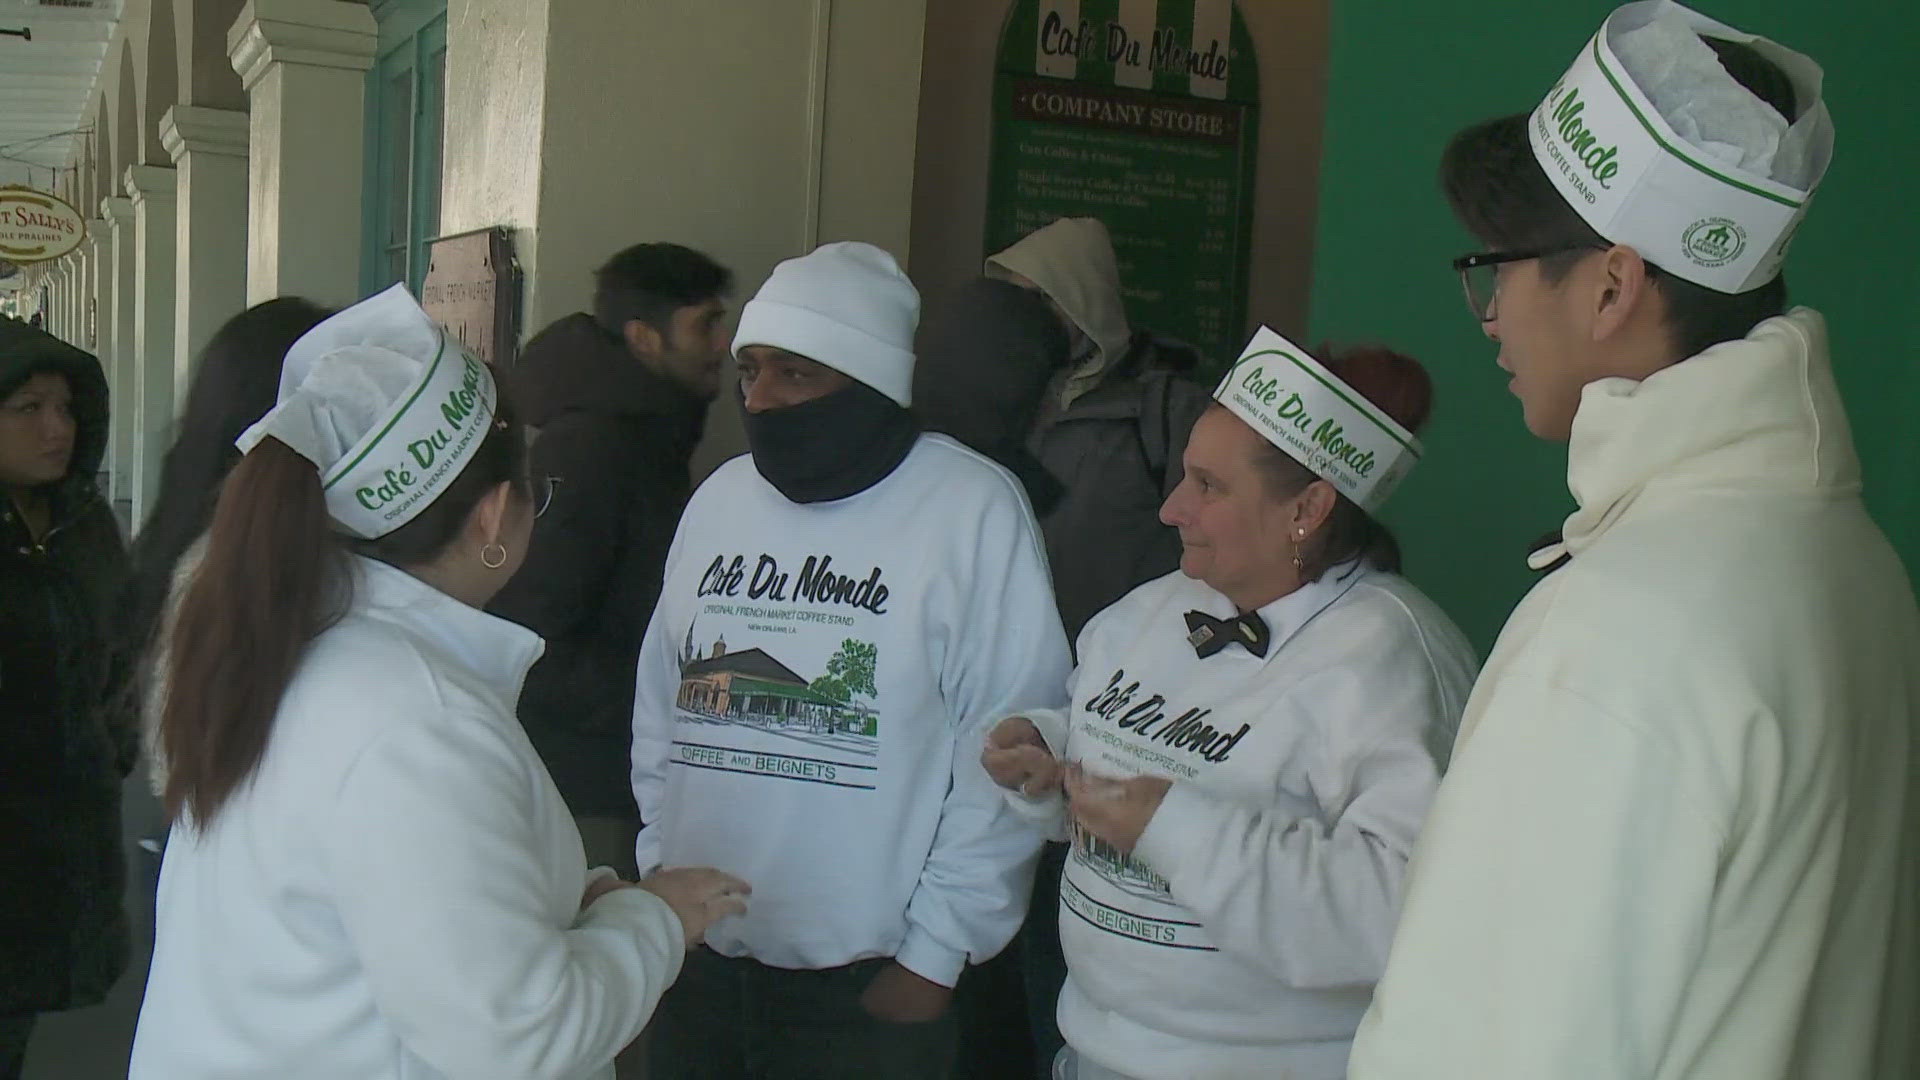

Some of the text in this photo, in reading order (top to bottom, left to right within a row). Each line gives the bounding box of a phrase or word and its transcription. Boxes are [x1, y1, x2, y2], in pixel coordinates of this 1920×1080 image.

[1106, 22, 1141, 66] Du
[1148, 28, 1227, 80] Monde
[1031, 93, 1225, 136] COMPANY STORE
[1551, 87, 1618, 190] Monde
[1546, 140, 1571, 176] COFFEE
[1568, 172, 1596, 204] STAND
[15, 206, 75, 234] SALLY'S
[18, 232, 62, 241] PRALINES
[1232, 393, 1260, 418] ORIGINAL
[1259, 413, 1287, 438] FRENCH
[1242, 366, 1375, 479] Café Du Monde
[356, 462, 418, 510] Café
[407, 429, 452, 470] Du
[423, 459, 453, 491] FRENCH
[451, 425, 477, 460] MARKET
[748, 553, 789, 602] Du
[792, 555, 889, 615] Monde
[704, 604, 855, 627] ORIGINAL FRENCH MARKET COFFEE STAND
[1118, 694, 1166, 736] Du
[1151, 707, 1251, 764] Mond
[682, 746, 837, 780] OFFEE AND BEIGNETS
[1096, 908, 1177, 942] BEIGNETS
